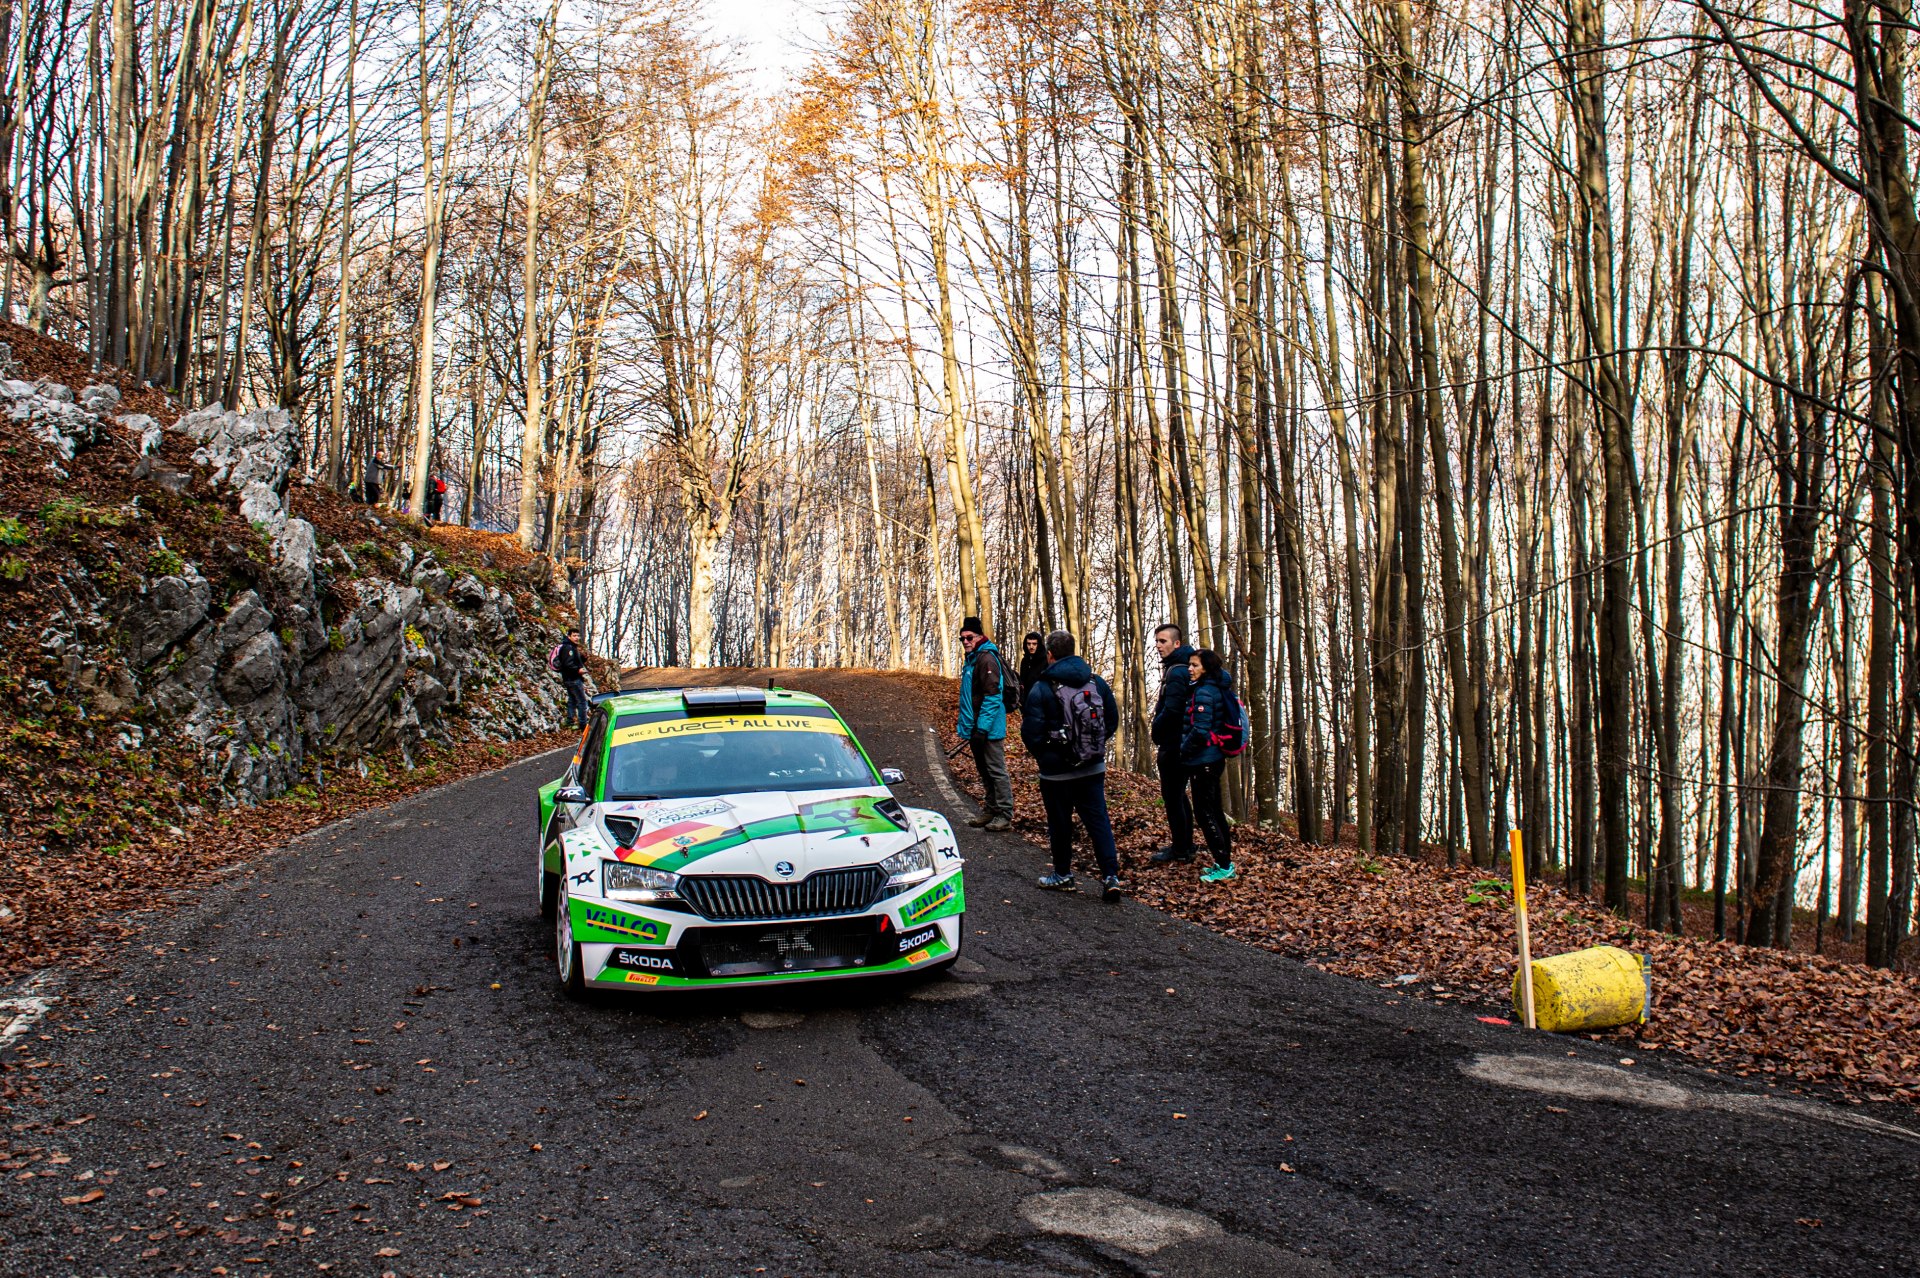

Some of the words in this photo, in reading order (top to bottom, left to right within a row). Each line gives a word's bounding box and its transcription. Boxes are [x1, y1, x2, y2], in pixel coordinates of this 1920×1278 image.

[627, 730, 645, 738] WRC
[743, 719, 773, 728] ALL
[776, 719, 812, 729] LIVE
[899, 929, 935, 952] ŠKODA
[618, 951, 674, 970] ŠKODA
